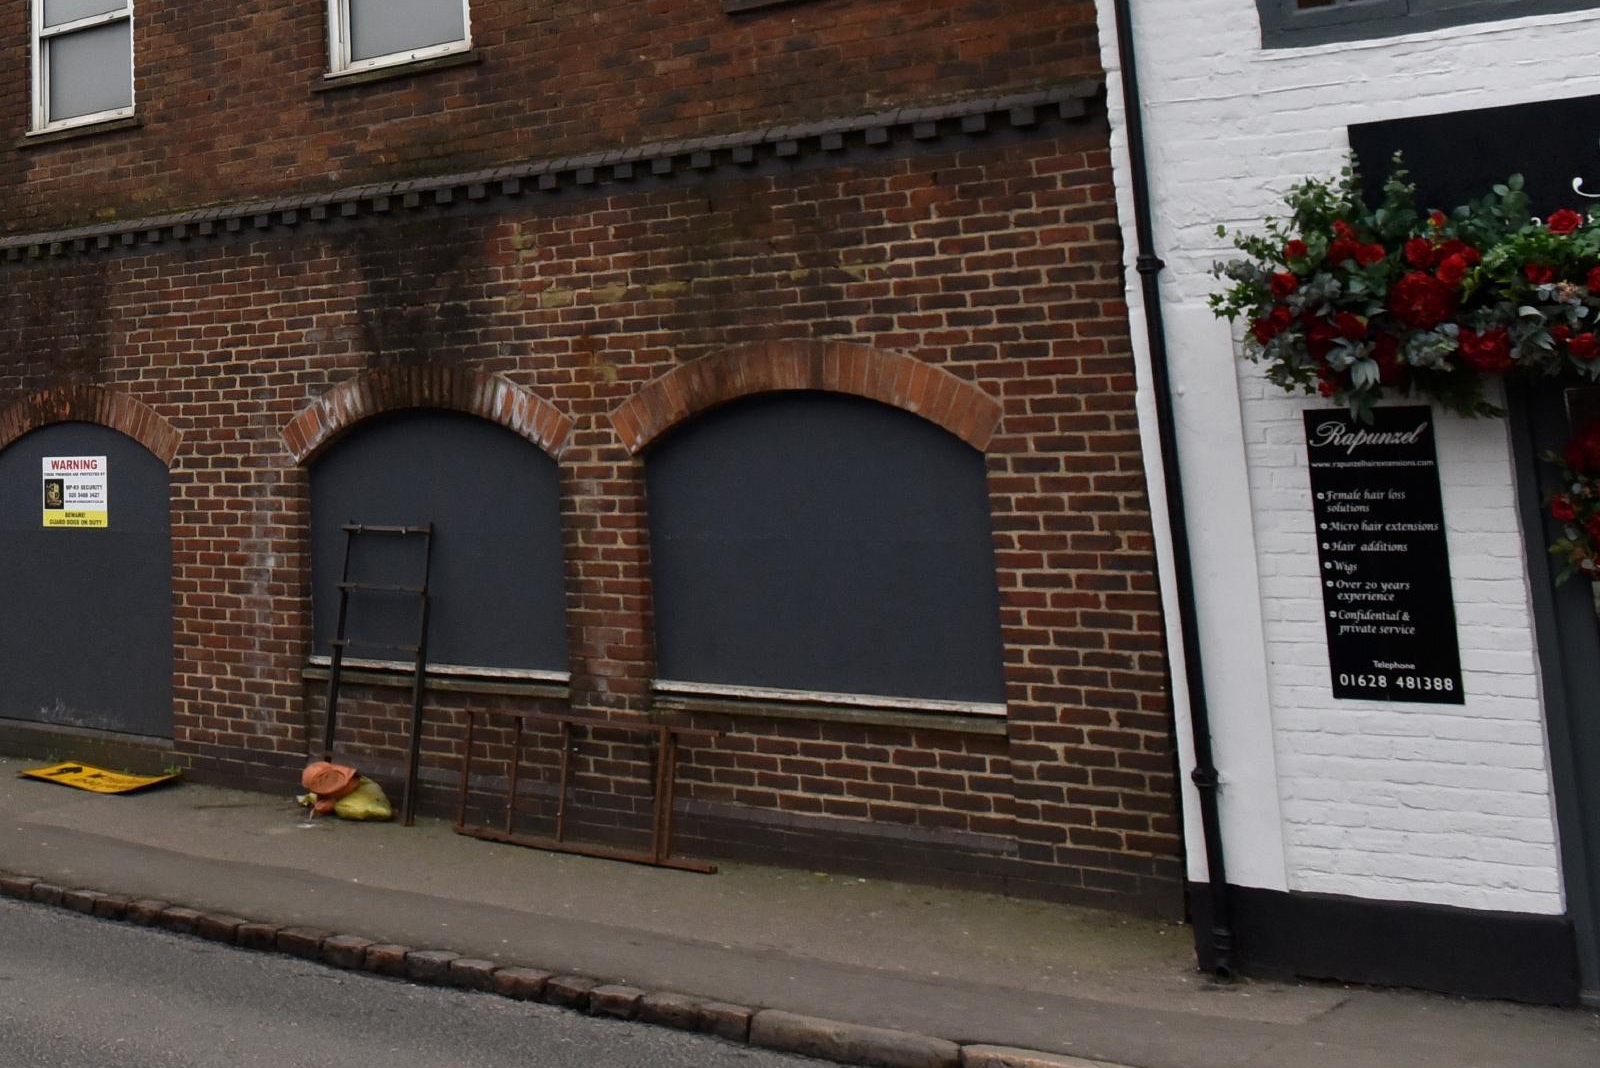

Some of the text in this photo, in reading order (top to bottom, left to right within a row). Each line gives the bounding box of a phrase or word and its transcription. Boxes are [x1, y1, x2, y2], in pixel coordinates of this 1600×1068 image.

[1309, 421, 1428, 455] Rapunzel
[51, 459, 98, 470] WARNING
[1325, 489, 1406, 502] Female hair loss
[1327, 502, 1370, 513] solutions
[1329, 520, 1440, 532] Micro hair extensions
[1331, 540, 1409, 552] Hair additions
[1333, 560, 1358, 575] Wigs
[1336, 579, 1362, 589] Over
[1380, 582, 1411, 592] years
[1337, 592, 1396, 603] experience
[1338, 609, 1411, 623] Confidential &
[1338, 624, 1416, 636] private service
[1372, 660, 1416, 670] Telephone
[1339, 673, 1454, 691] 01628 481388
